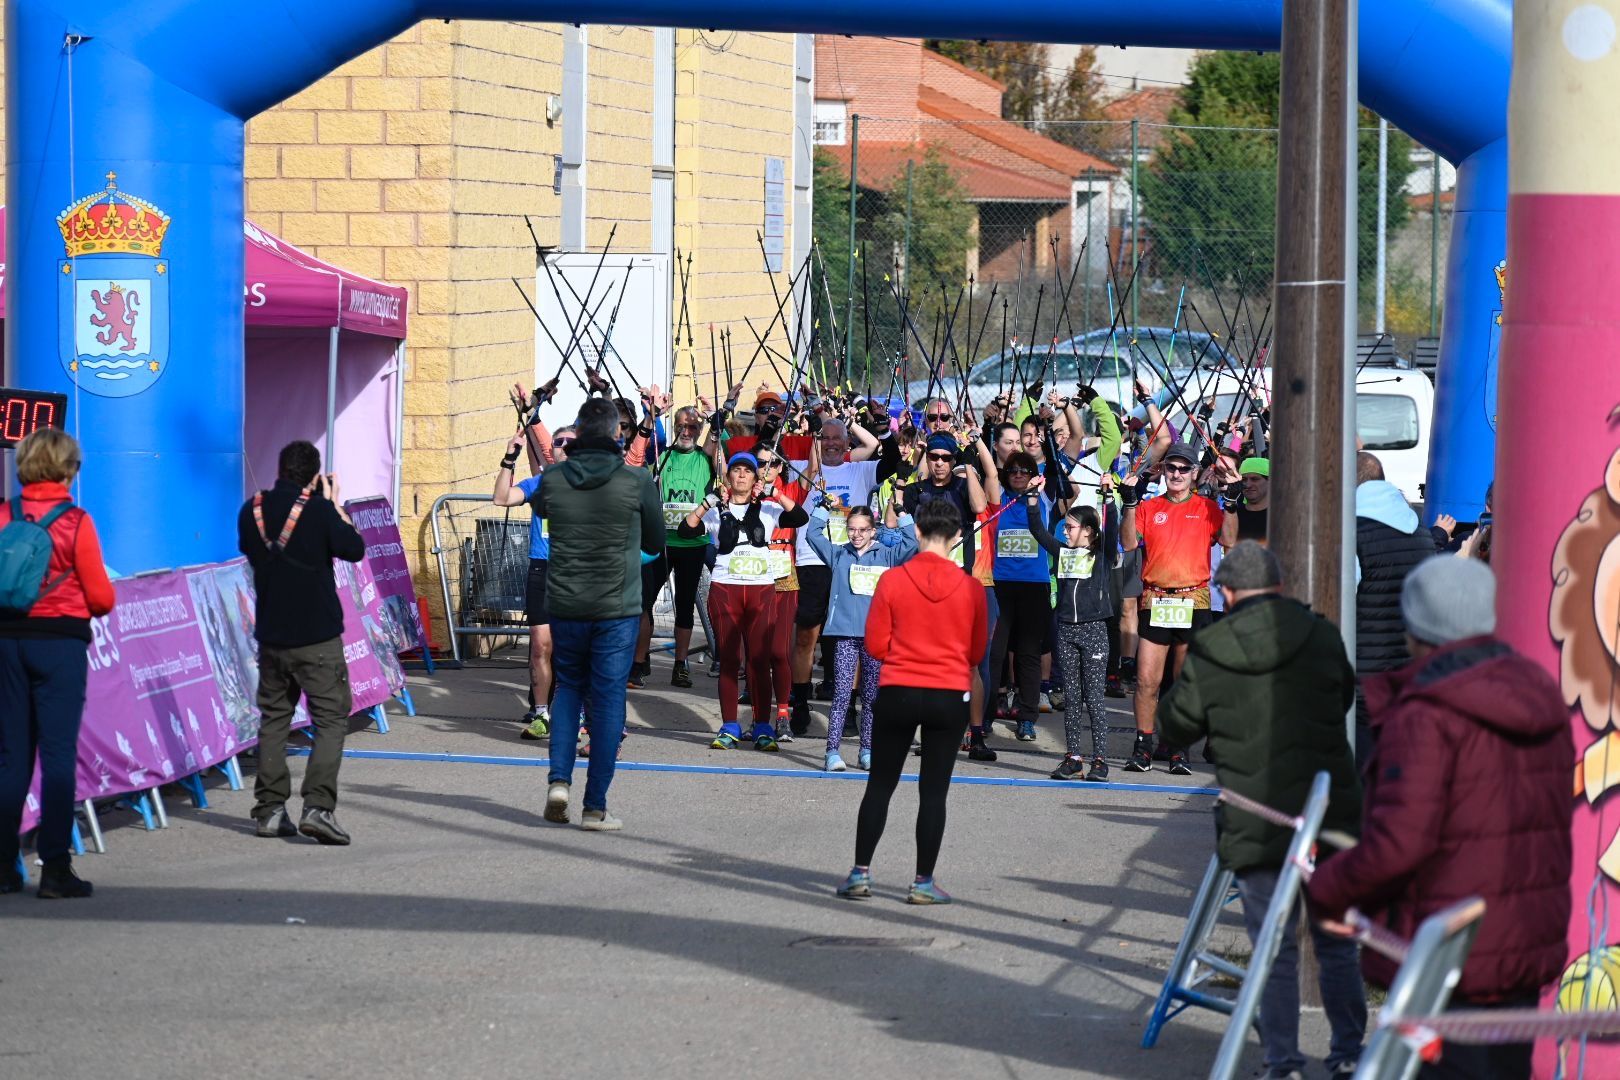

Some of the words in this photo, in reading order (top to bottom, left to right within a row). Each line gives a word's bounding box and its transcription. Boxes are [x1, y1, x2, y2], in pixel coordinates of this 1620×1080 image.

[244, 282, 266, 307] s
[665, 511, 690, 525] 34
[1002, 538, 1031, 552] 325
[733, 559, 763, 575] 340
[1062, 556, 1088, 573] 354
[854, 573, 876, 589] 35
[1156, 607, 1187, 622] 310
